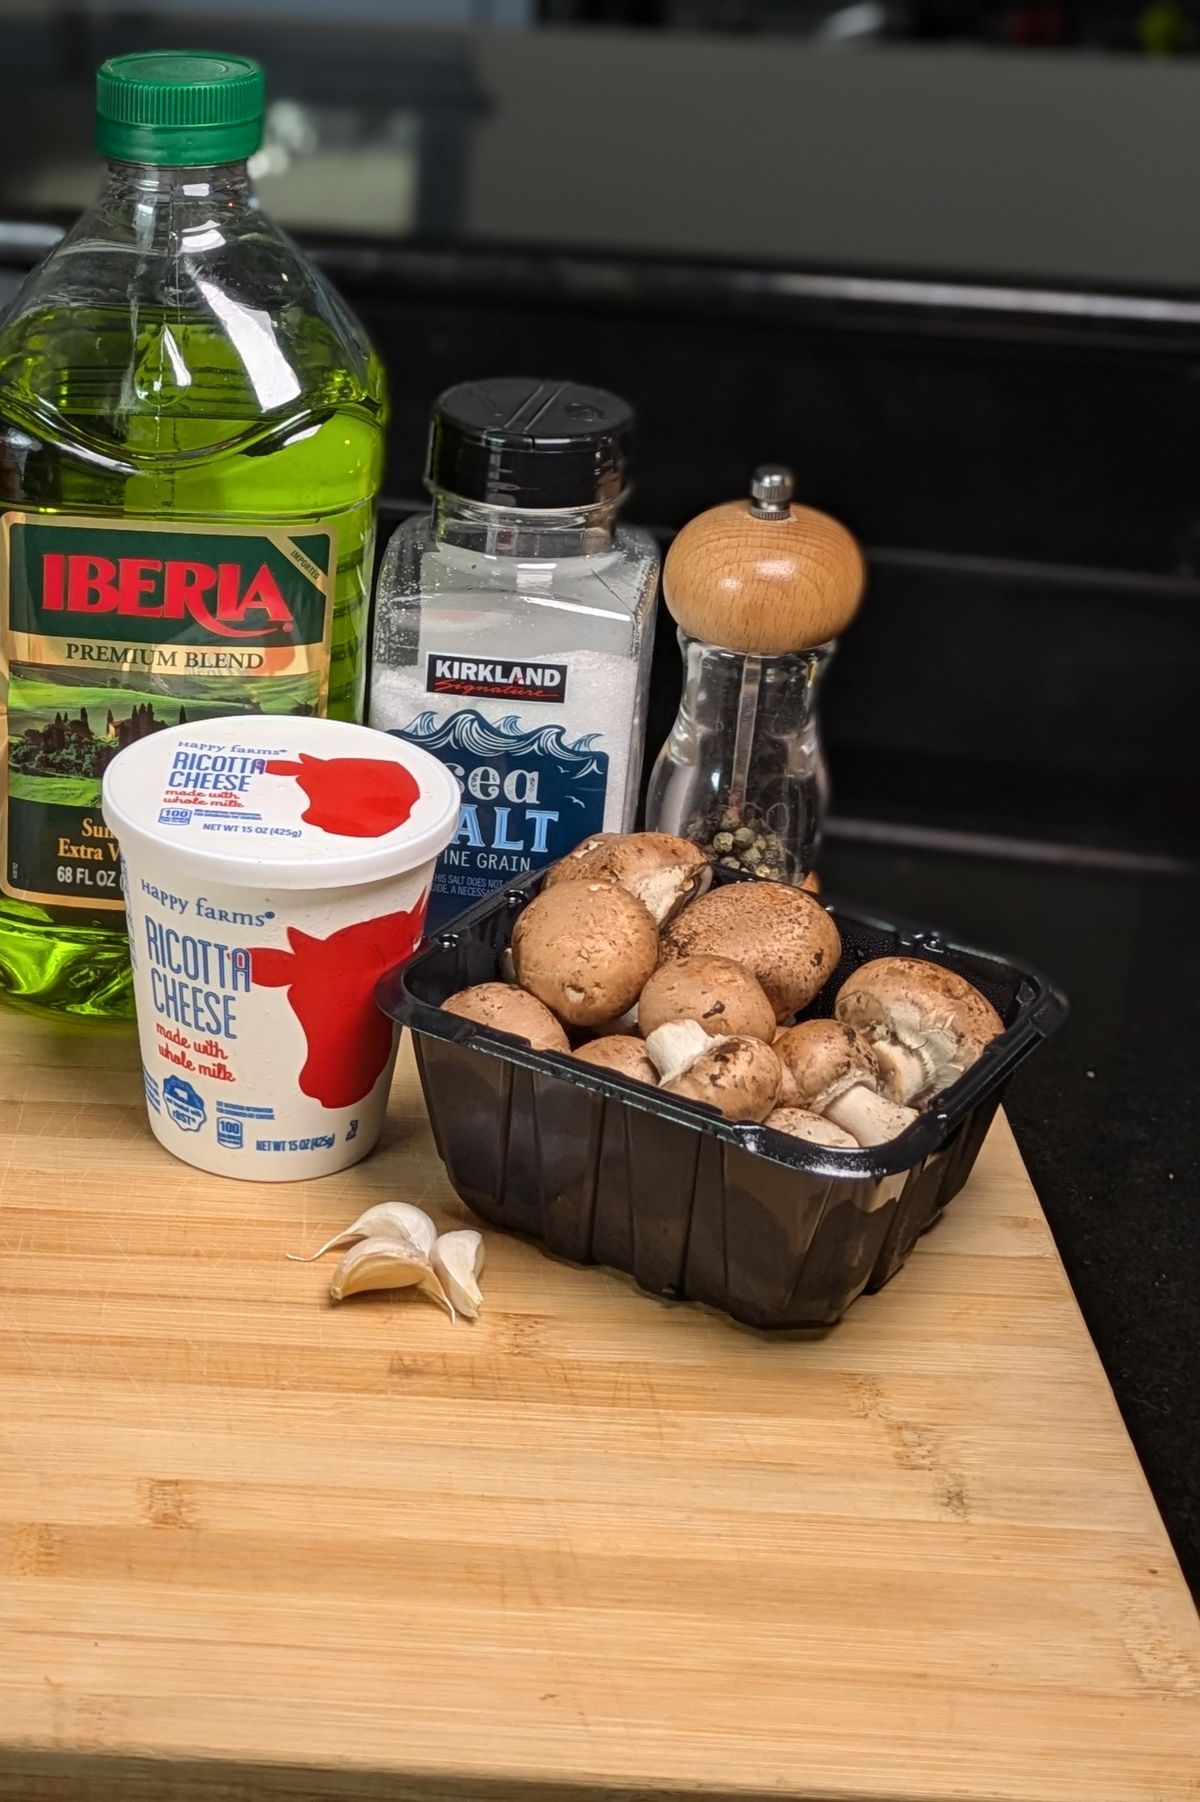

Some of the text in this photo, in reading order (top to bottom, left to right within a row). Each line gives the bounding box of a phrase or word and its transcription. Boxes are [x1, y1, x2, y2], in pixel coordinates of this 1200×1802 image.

[290, 550, 320, 580] IMPORTED
[42, 553, 294, 638] IBERIA
[65, 642, 264, 669] PREMIUM BLEND
[435, 659, 561, 687] KIRKLAND
[434, 679, 560, 698] Signature
[172, 751, 266, 775] RICOTTA
[167, 771, 252, 792] CHEESE
[163, 796, 245, 808] whole milk
[208, 791, 240, 799] with
[165, 810, 189, 818] 100
[202, 823, 302, 838] NET WT 15 OZ (425g)
[451, 804, 559, 853] ALT
[58, 838, 103, 860] Extra
[443, 849, 530, 872] INE GRAIN
[56, 866, 116, 887] 68 FL OZ
[435, 874, 446, 883] HIS
[448, 875, 465, 885] SALT
[467, 877, 486, 887] DOES
[451, 886, 457, 895] A
[145, 914, 251, 993] RICOTTA
[151, 967, 237, 1040] CHEESE
[156, 1022, 228, 1060] made with
[158, 1042, 236, 1082] whole milk
[220, 1121, 240, 1134] 100
[256, 1140, 271, 1151] NET
[272, 1140, 286, 1151] WT
[288, 1141, 298, 1152] 15
[299, 1139, 310, 1151] OZ
